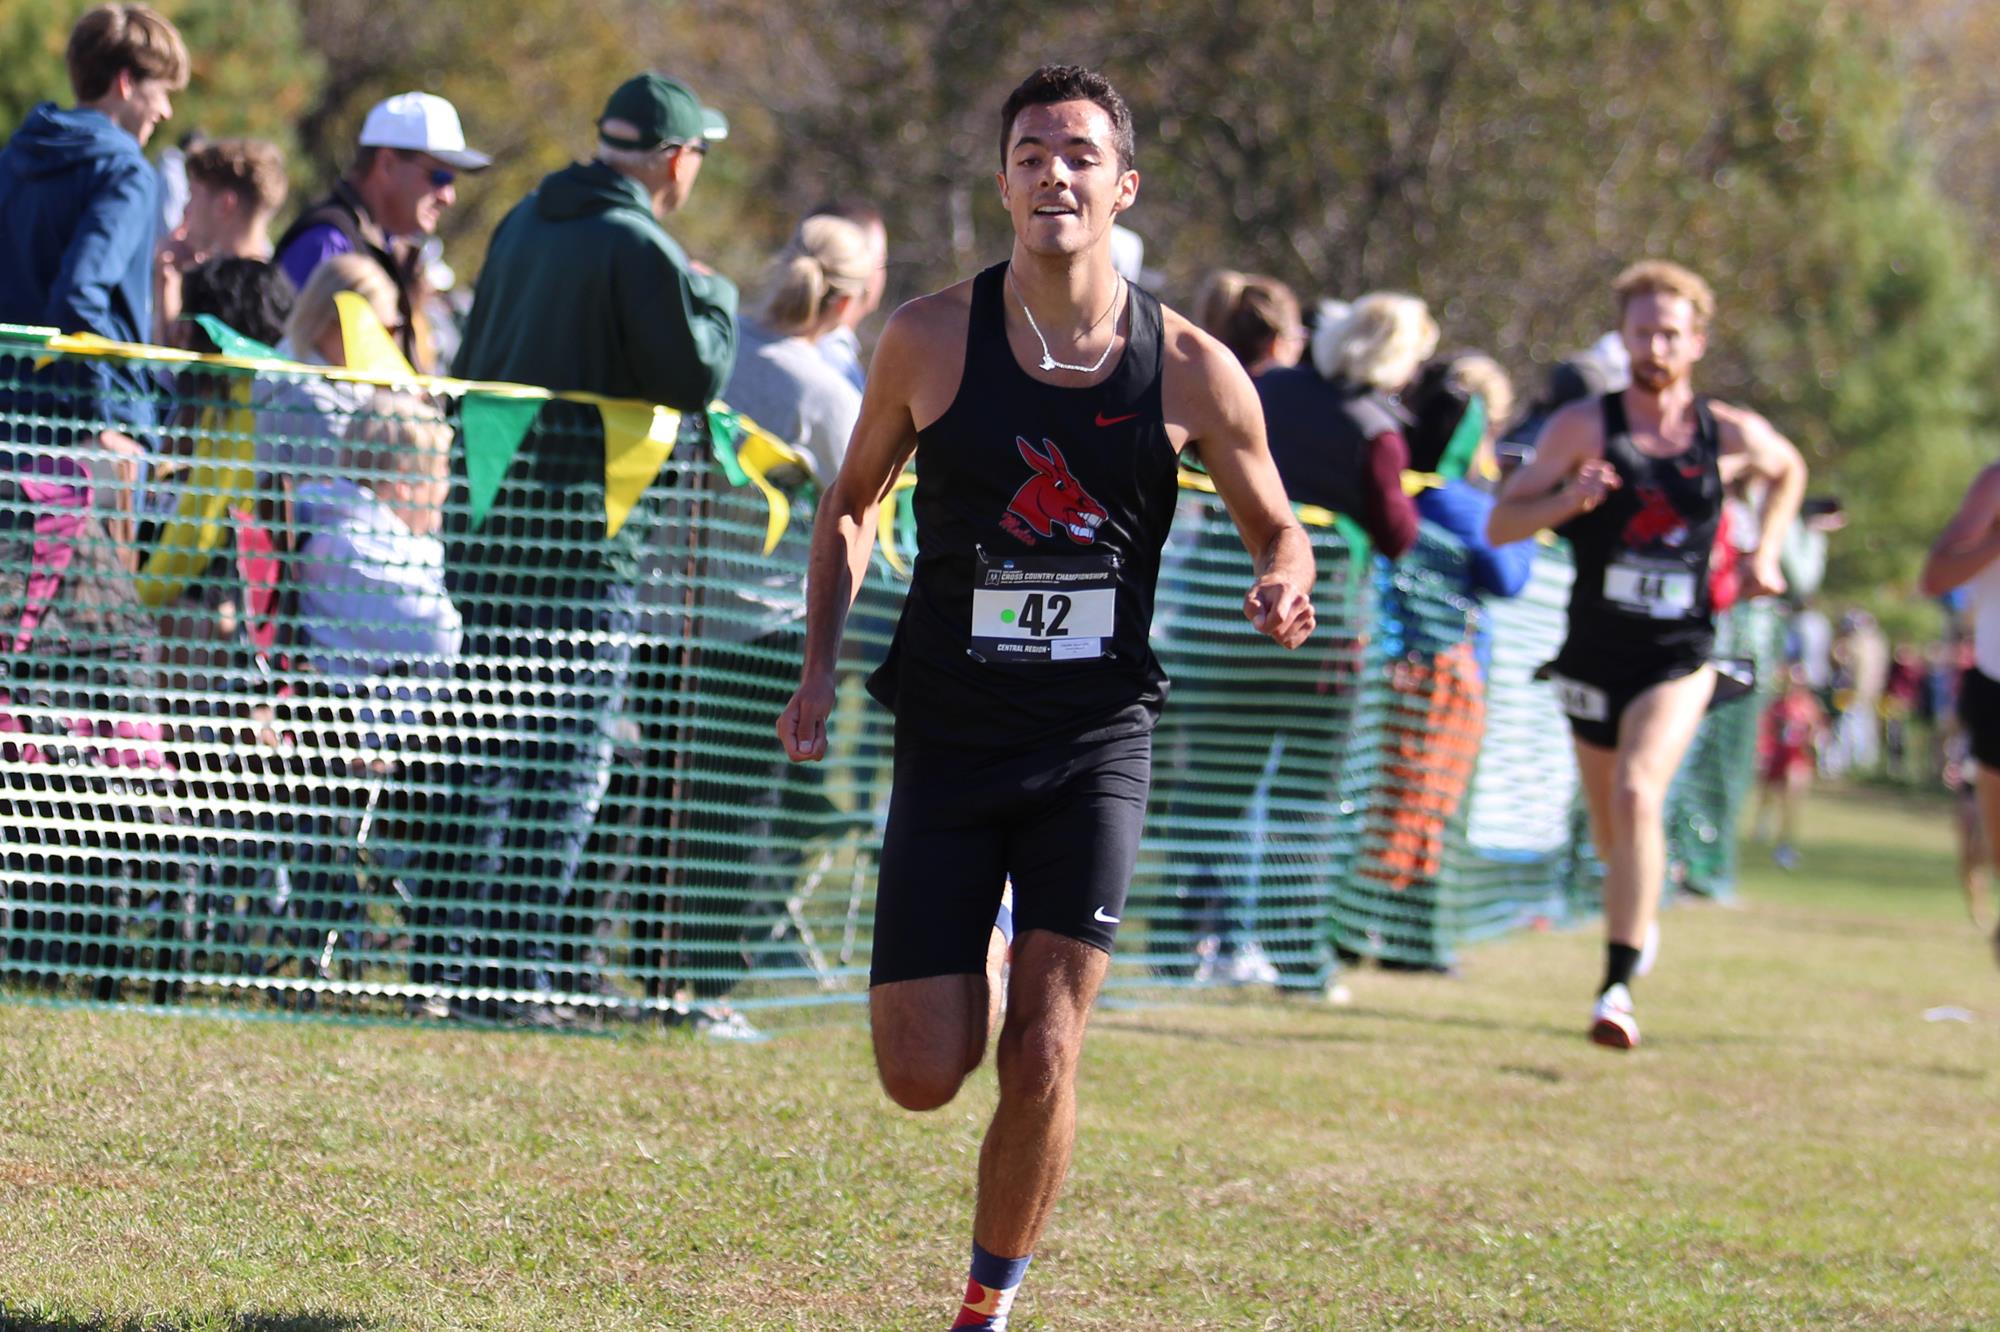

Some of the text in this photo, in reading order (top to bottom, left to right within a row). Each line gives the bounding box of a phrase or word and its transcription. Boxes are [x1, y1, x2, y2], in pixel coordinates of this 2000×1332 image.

[1001, 572, 1108, 581] CROSS COUNTRY CHAMPIONSHIPS
[1018, 593, 1071, 637] 42
[997, 643, 1046, 653] CENTRAL REGION
